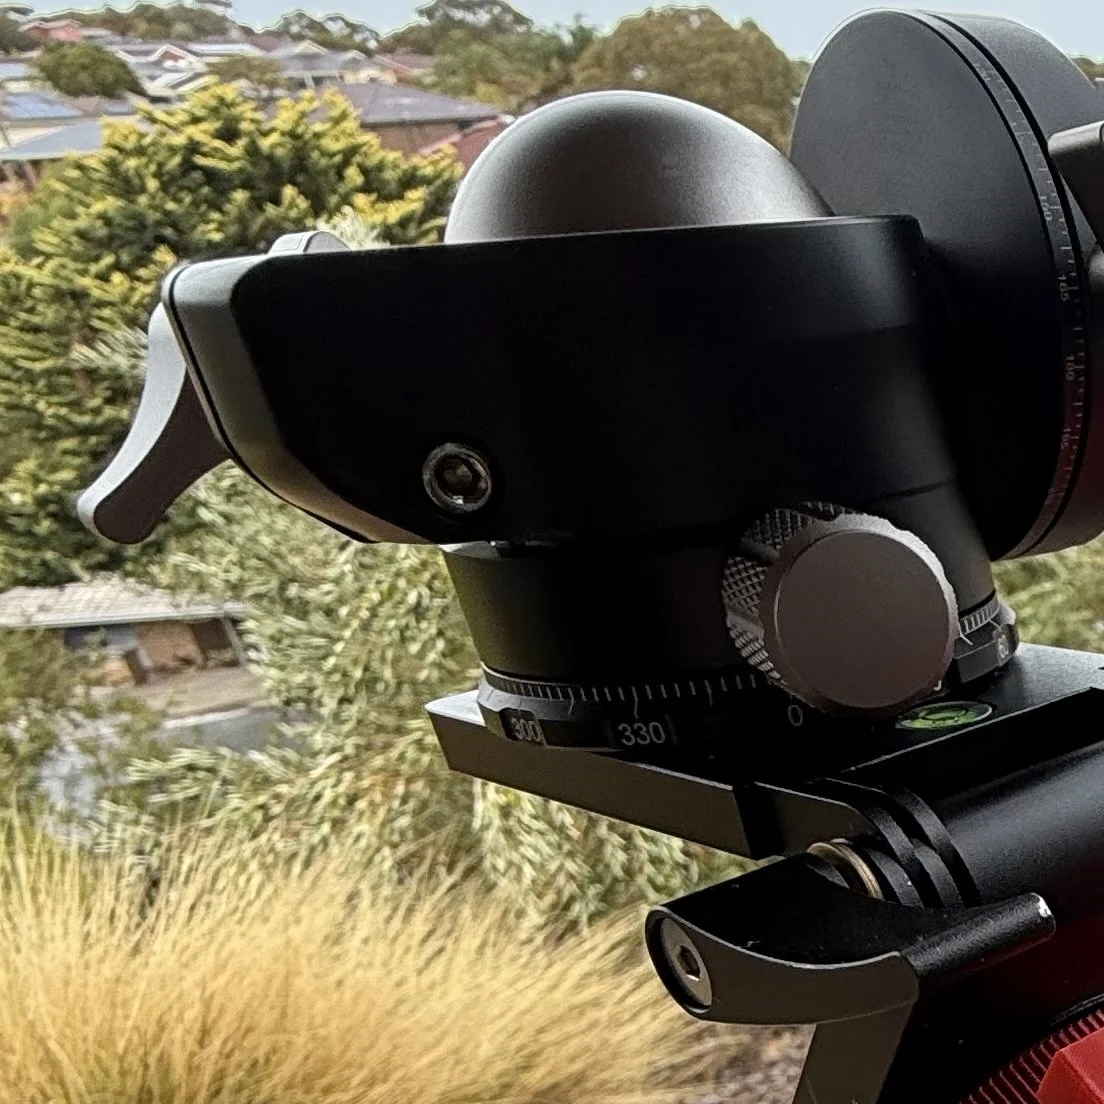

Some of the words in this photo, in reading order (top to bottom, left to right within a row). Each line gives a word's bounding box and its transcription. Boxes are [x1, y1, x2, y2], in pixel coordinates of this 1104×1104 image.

[787, 704, 804, 726] 0
[511, 718, 543, 742] 300
[617, 721, 666, 746] 330
